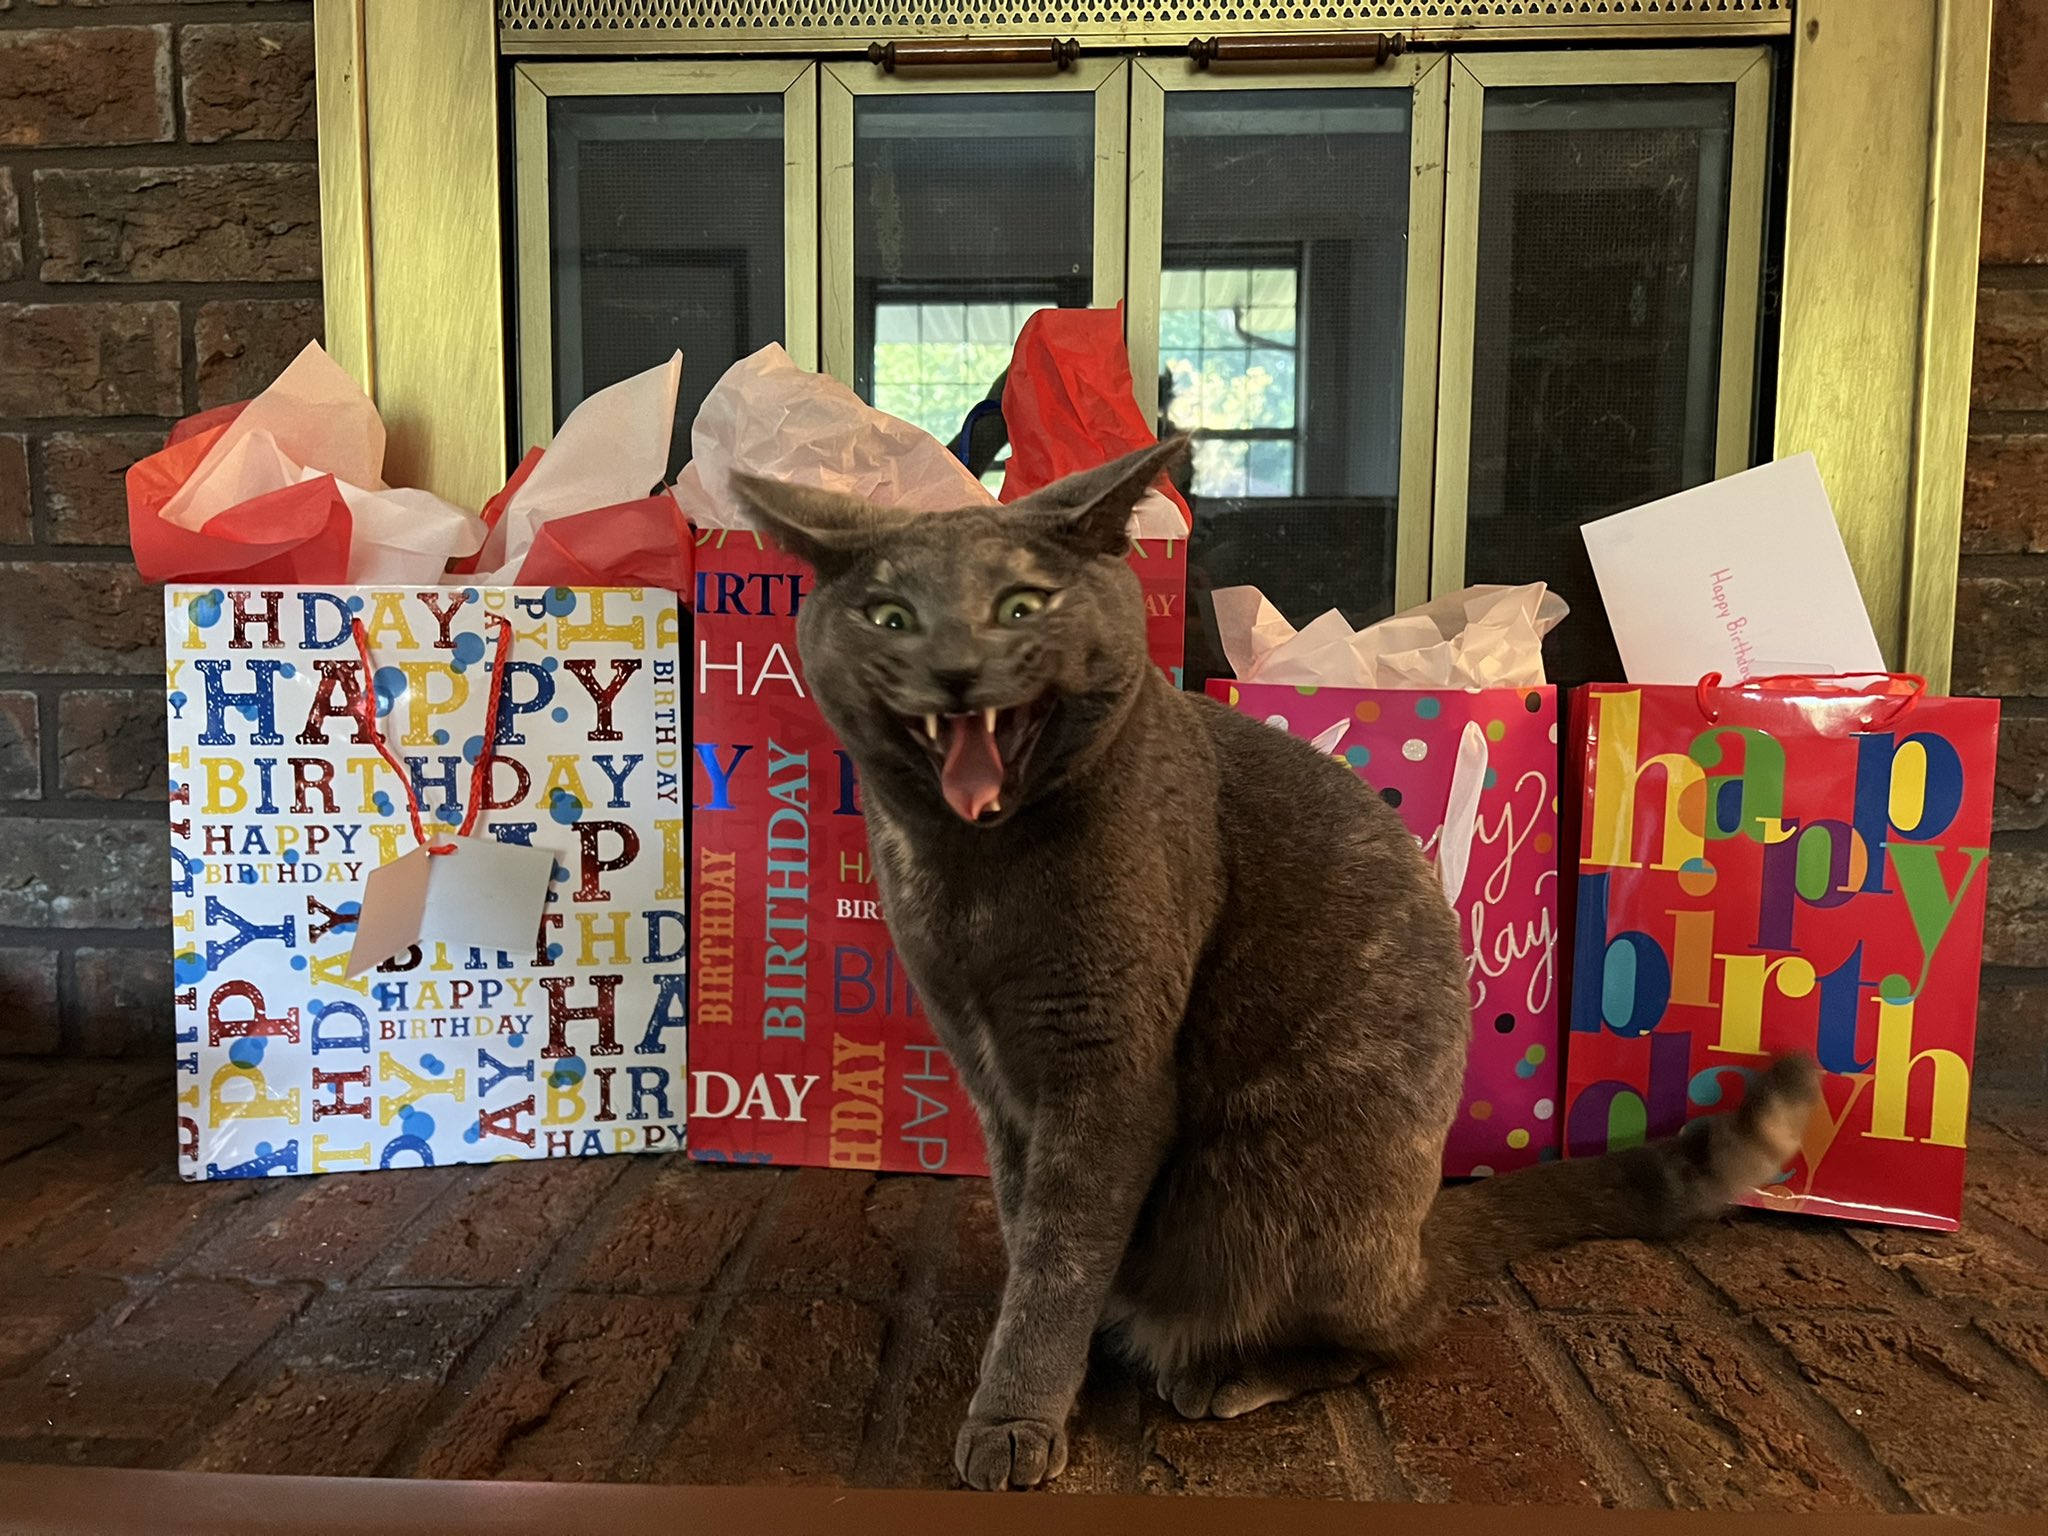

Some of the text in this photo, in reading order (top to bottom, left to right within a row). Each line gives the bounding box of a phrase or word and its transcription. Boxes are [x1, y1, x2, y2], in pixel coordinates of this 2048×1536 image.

[1709, 567, 1733, 619] Happy
[194, 659, 643, 746] HAPPY
[653, 660, 678, 805] BIRTHDAY
[200, 753, 644, 815] BIRTHDAY
[202, 824, 362, 855] HAPPY
[1579, 688, 1990, 1006] happy
[205, 862, 363, 884] BIRTHDAY
[763, 737, 811, 1042] BIRTHDAY
[697, 846, 737, 1026] BIRTHDAY
[378, 978, 534, 1012] HAPPY
[1570, 870, 1968, 1149] birth
[379, 1014, 534, 1040] BIRTHDAY
[690, 1070, 821, 1123] DAY
